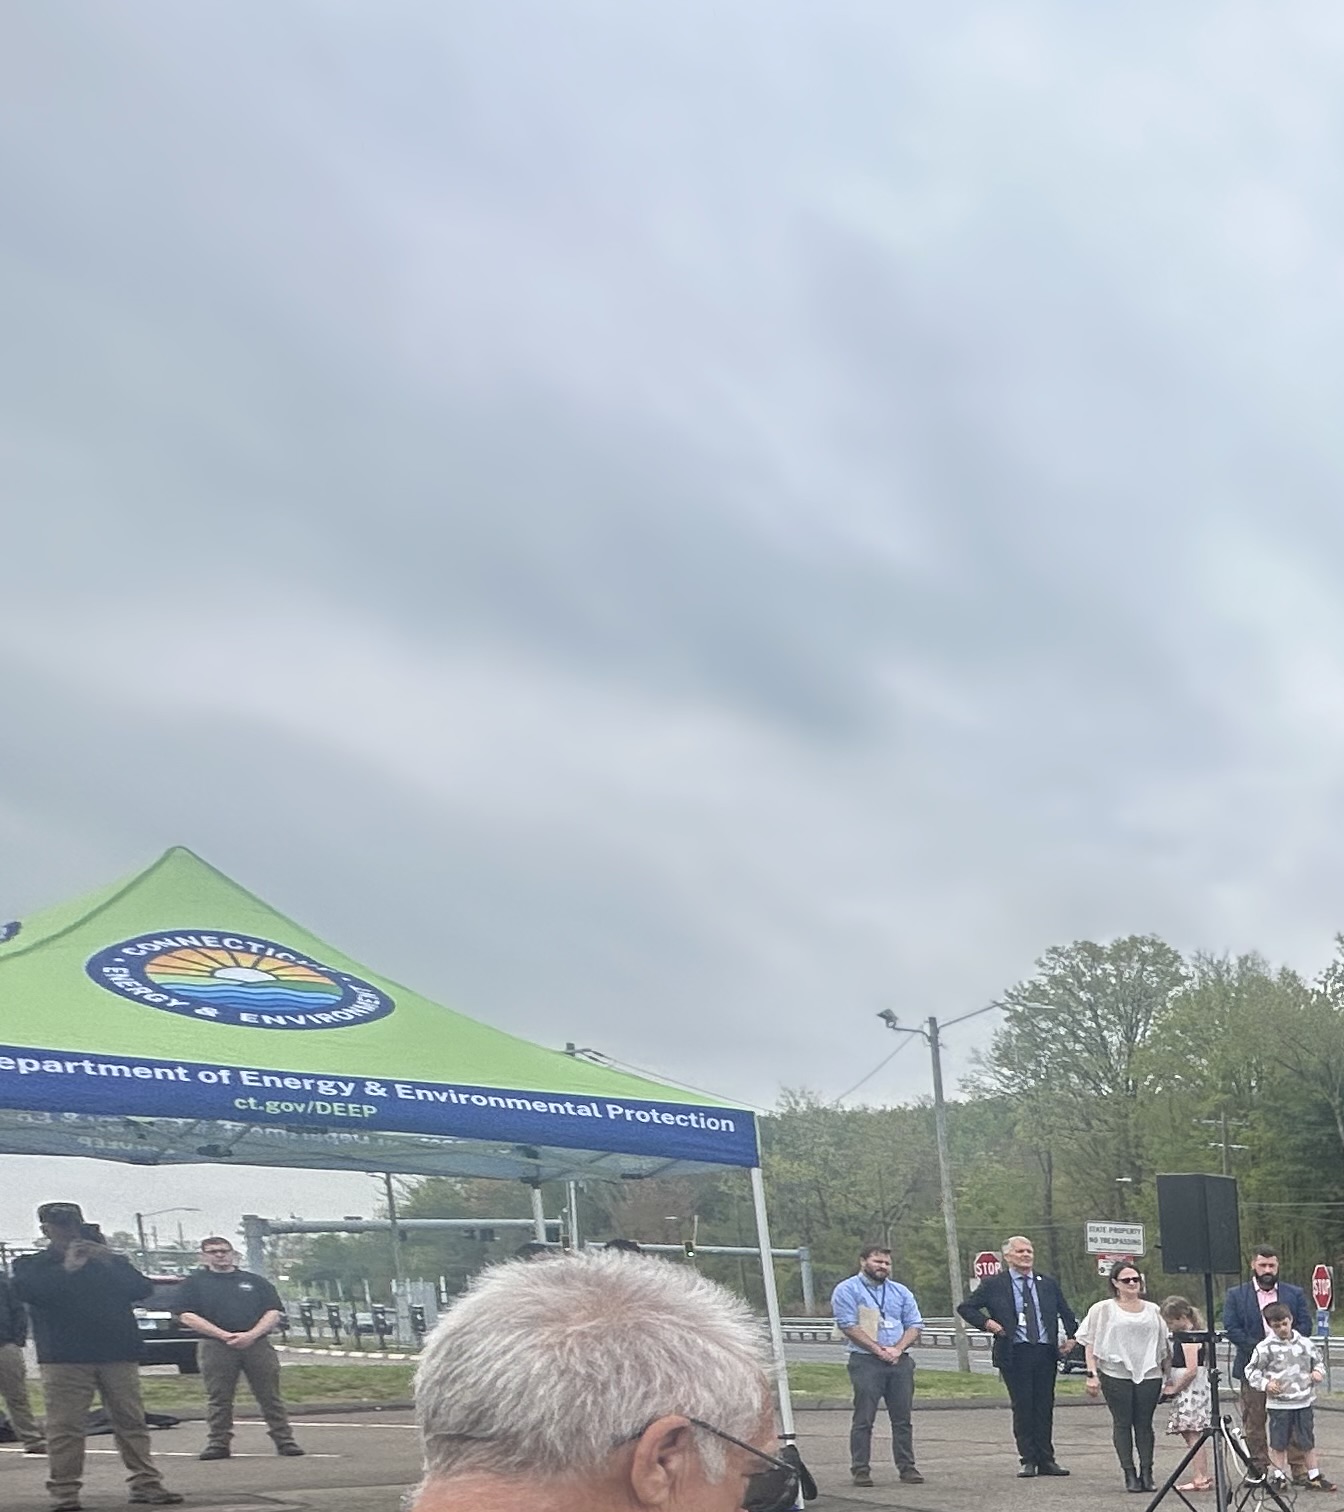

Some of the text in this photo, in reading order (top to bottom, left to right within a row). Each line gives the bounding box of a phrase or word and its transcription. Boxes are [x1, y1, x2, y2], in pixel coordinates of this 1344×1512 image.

[121, 934, 329, 972] CONNECTIC
[103, 966, 382, 1026] ENERGY & ENVIRONMENT
[198, 1069, 232, 1085] of
[241, 1070, 355, 1097] Energy
[364, 1080, 388, 1097] &
[395, 1084, 603, 1119] Environmental
[606, 1103, 736, 1133] Protection
[233, 1096, 378, 1118] ct.gov/DEEP
[975, 1262, 1001, 1276] STOP
[1312, 1279, 1331, 1295] STOP
